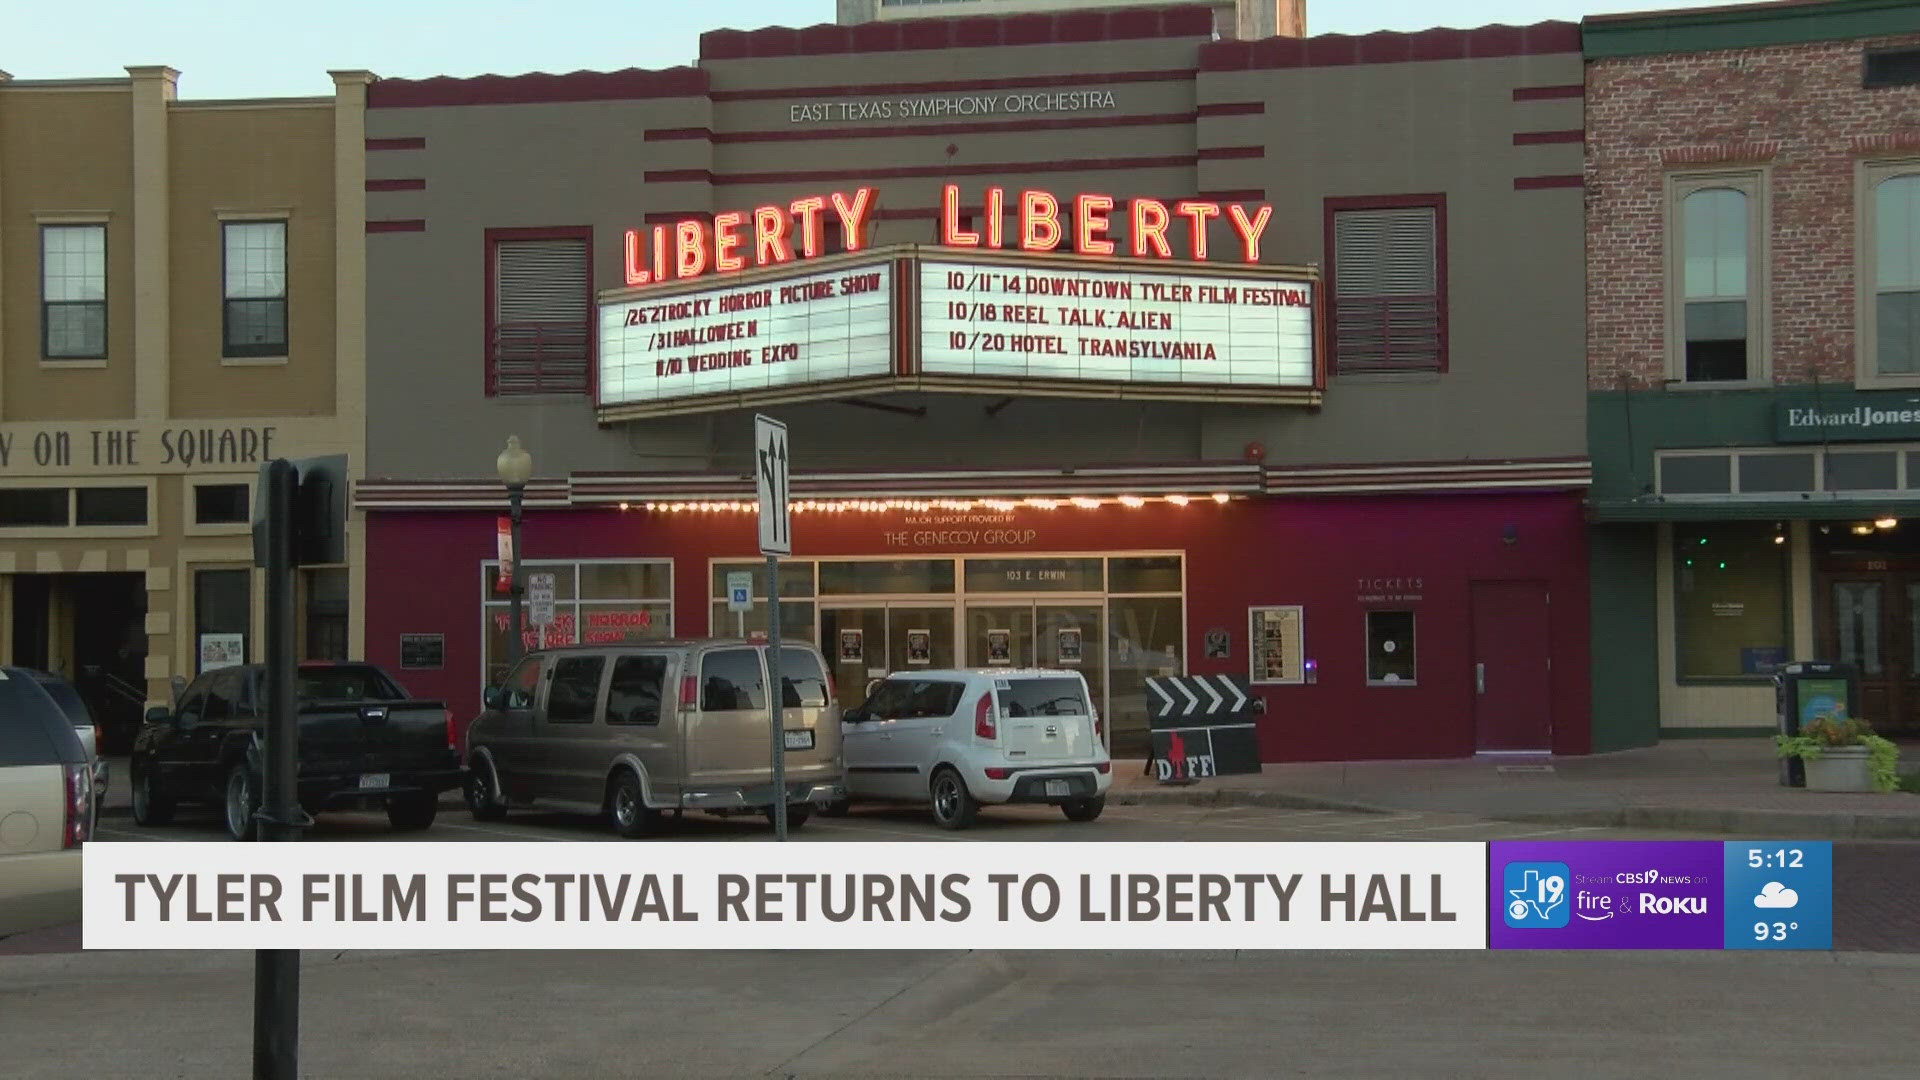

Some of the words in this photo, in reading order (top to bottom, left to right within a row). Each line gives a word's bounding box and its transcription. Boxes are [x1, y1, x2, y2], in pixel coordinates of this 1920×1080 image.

[791, 104, 832, 122] EAST
[839, 101, 892, 121] TEXAS
[899, 96, 997, 117] SYMPHONY
[1004, 91, 1116, 113] ORCHESTRA
[624, 187, 877, 286] LIBERTY
[941, 184, 1273, 263] LIBERTY
[669, 299, 711, 322] ROCKY
[719, 290, 772, 314] HORROR
[780, 279, 835, 304] PICTURE
[840, 273, 881, 296] SHOW
[1026, 275, 1132, 300] DOWNTOWN
[1140, 283, 1193, 302] TYLER
[1199, 285, 1237, 304] FILM
[1243, 288, 1312, 308] FESTIVAL
[948, 301, 997, 322] 10/18
[1003, 304, 1049, 324] REEL
[1117, 311, 1172, 330] ALIEN
[673, 320, 757, 347] HALLOWEEN
[950, 331, 1004, 351] 10/20
[1011, 334, 1067, 354] HOTEL
[1078, 337, 1217, 361] TRANSYLVANIA
[688, 350, 752, 374] WEDDING
[762, 343, 798, 364] EXPO
[33, 431, 70, 466] ON
[90, 430, 140, 466] THE
[160, 426, 277, 467] SQUARE
[905, 516, 932, 525] MAJOR
[934, 516, 967, 524] SUPPORT
[969, 515, 1005, 524] PROVIDED
[1006, 514, 1016, 523] BY
[885, 531, 909, 546] THE
[913, 530, 980, 546] GENECOV
[984, 529, 1036, 545] GROUP
[1006, 571, 1021, 581] 103
[1038, 570, 1066, 580] ERWIN
[1358, 577, 1424, 590] TICKETS
